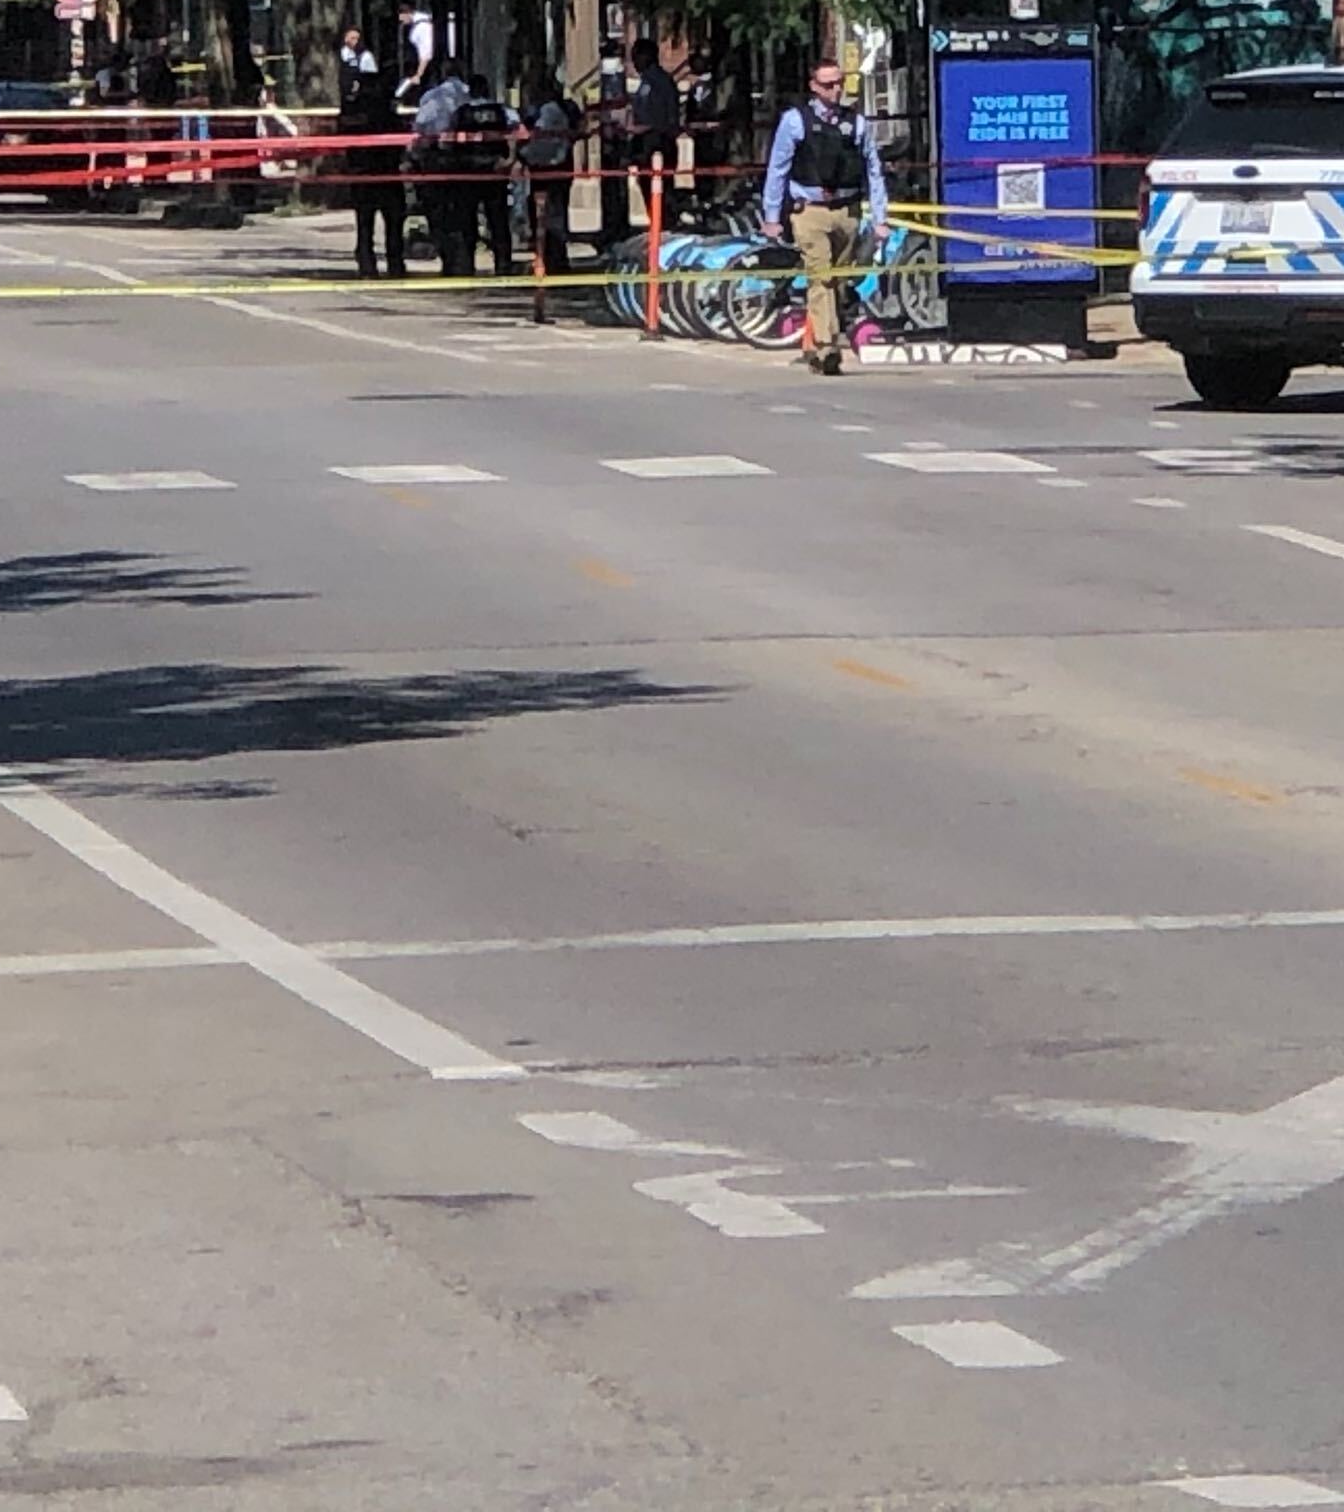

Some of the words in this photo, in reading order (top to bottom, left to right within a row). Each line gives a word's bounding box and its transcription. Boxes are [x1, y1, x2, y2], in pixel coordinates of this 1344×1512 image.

[972, 96, 1019, 110] YOUR
[1022, 94, 1067, 109] FIRST
[968, 127, 1007, 141] RIDE
[1010, 126, 1026, 140] IS
[1029, 126, 1069, 140] FREE
